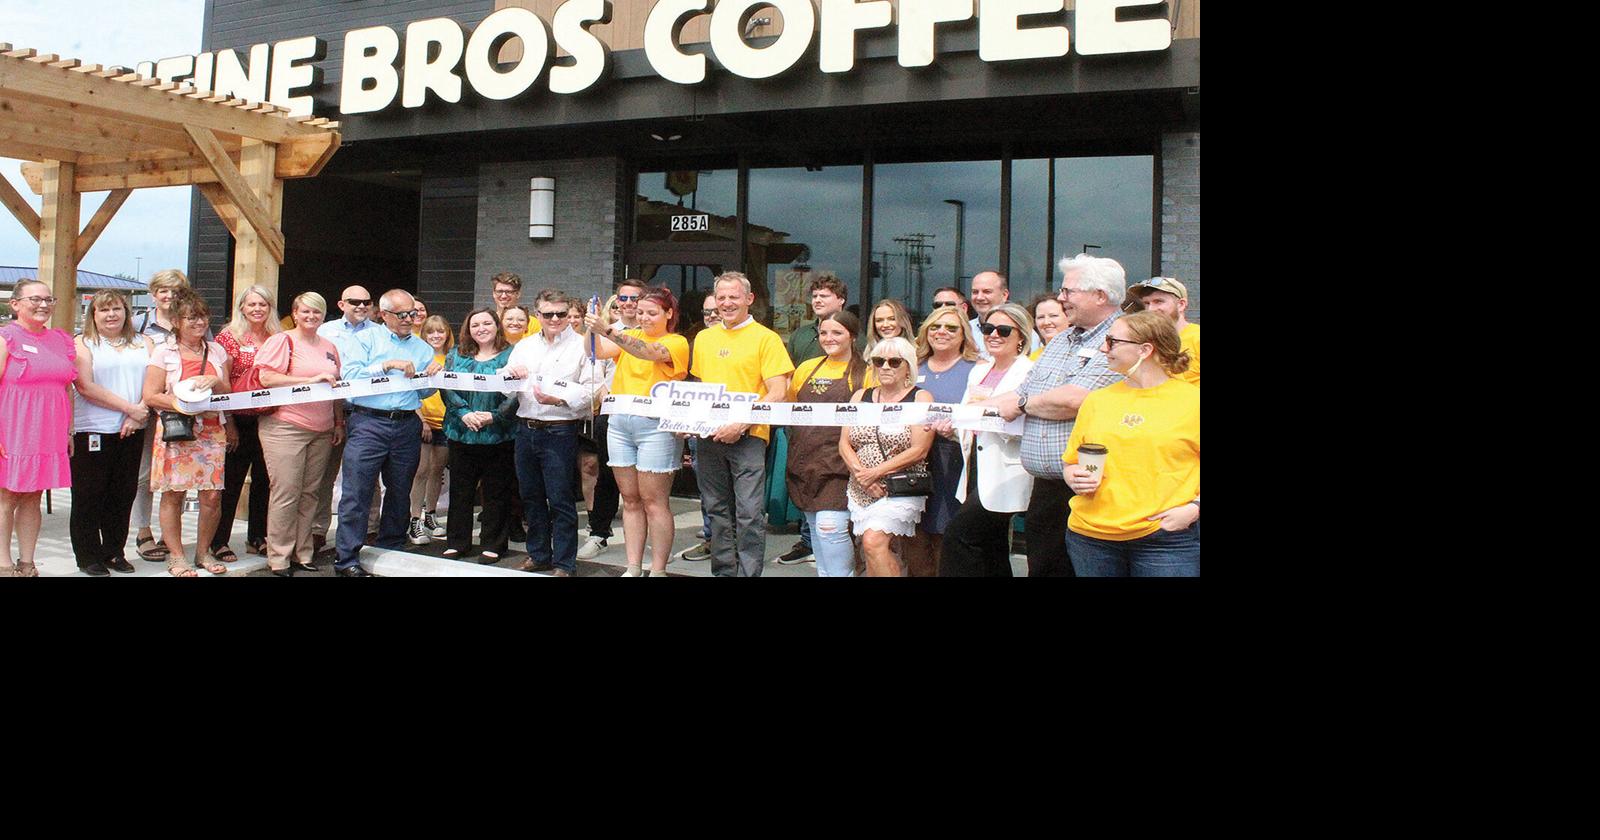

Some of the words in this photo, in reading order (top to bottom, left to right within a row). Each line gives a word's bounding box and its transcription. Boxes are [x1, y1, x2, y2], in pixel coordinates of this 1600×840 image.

[110, 36, 317, 117] INE
[340, 0, 606, 114] BROS
[643, 0, 1171, 84] COFFEE
[672, 215, 707, 231] 285A
[651, 382, 758, 402] Chamber
[660, 418, 690, 431] Better
